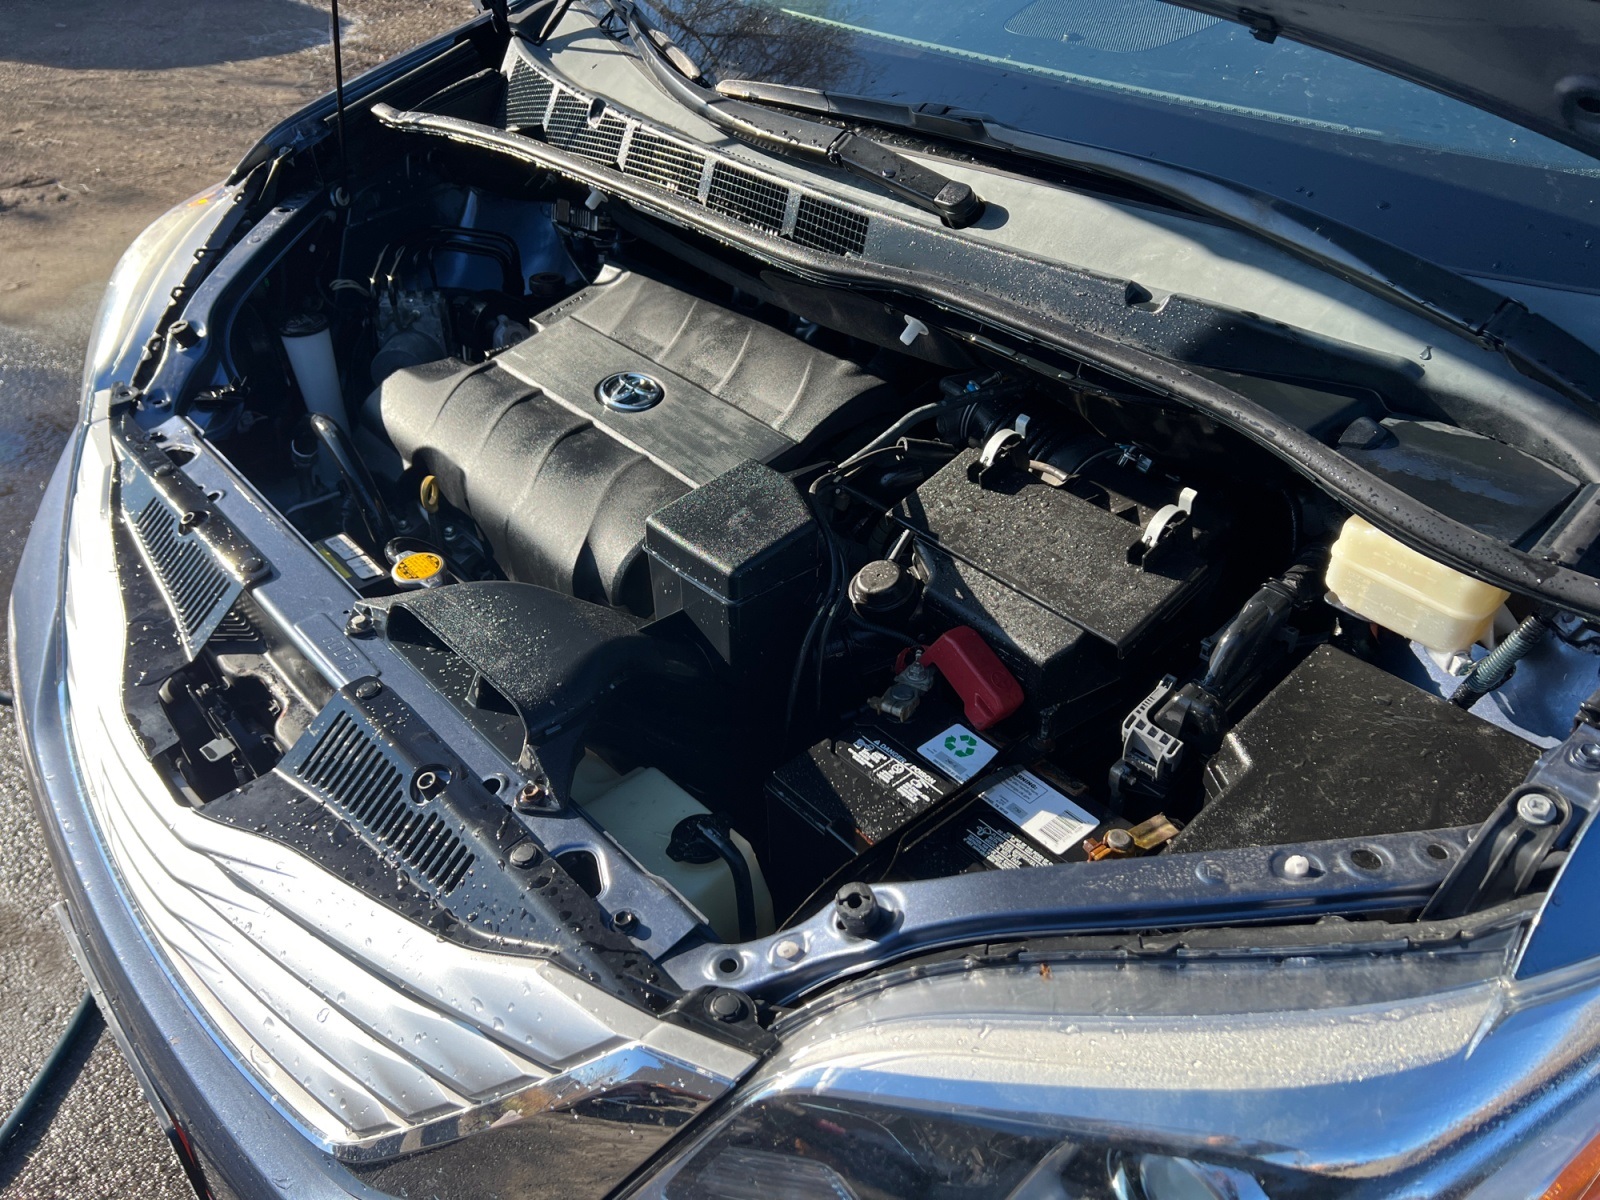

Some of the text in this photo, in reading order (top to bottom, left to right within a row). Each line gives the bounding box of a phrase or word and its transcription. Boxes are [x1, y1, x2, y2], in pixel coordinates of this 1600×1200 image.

[879, 743, 907, 764] DANGER
[909, 765, 937, 785] POISON
[1015, 773, 1038, 790] ARNING:
